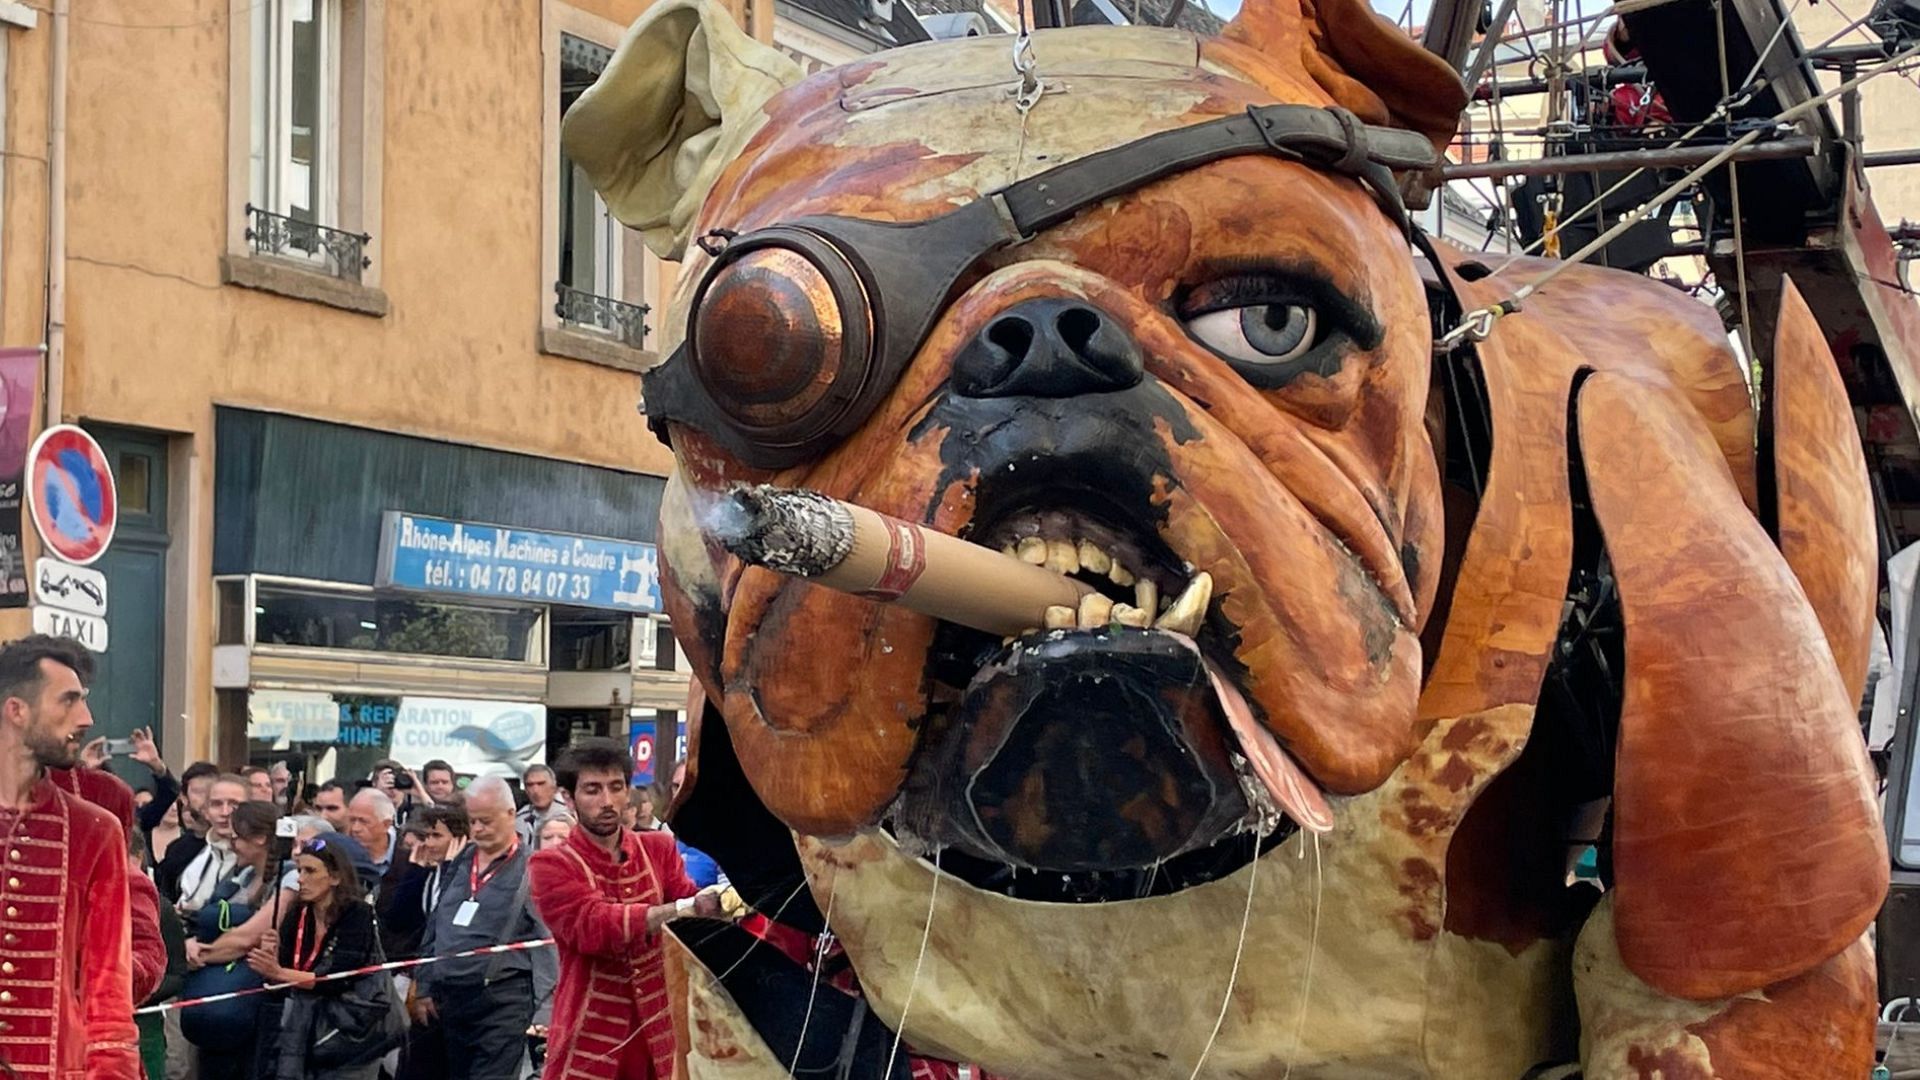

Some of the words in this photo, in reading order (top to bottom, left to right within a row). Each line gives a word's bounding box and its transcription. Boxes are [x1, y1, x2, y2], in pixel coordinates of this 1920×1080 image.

[400, 517, 491, 560] Rhône-Alpes
[494, 529, 558, 565] Machines
[561, 544, 570, 566] à
[573, 540, 616, 571] Coudre
[425, 560, 453, 587] tél.
[471, 563, 491, 590] 04
[497, 566, 517, 593] 78
[521, 568, 542, 595] 84
[546, 571, 567, 597] 07
[570, 574, 590, 600] 33
[50, 613, 94, 645] TAXI
[265, 701, 334, 720] VENTE
[340, 704, 353, 722] &
[360, 705, 472, 726] REPARATION
